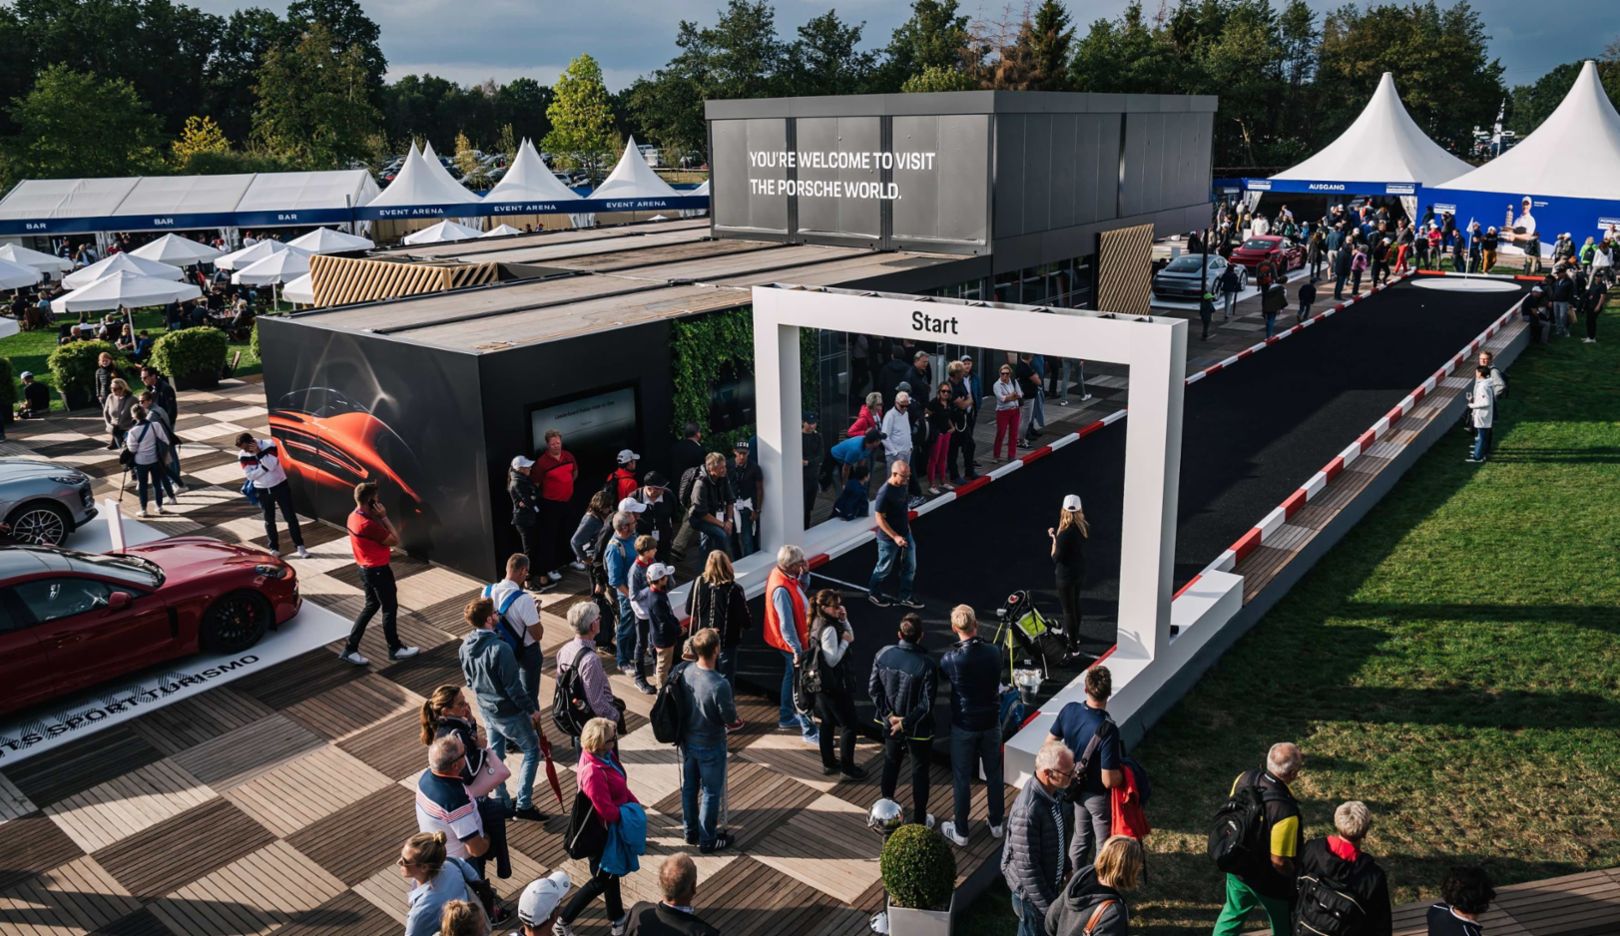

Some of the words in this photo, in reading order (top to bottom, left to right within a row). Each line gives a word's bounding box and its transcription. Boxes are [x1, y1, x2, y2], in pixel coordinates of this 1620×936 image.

[750, 151, 796, 168] YOU'RE
[799, 151, 871, 169] WELCOME
[873, 152, 893, 170] TO
[897, 152, 935, 170] VISIT
[750, 178, 775, 195] THE
[778, 180, 842, 198] PORSCHE
[844, 182, 902, 200] WORLD.
[1308, 183, 1345, 191] AUSGANG
[494, 205, 523, 213] EVENT
[526, 203, 557, 212] ARENA
[606, 201, 634, 209] EVENT
[637, 200, 667, 208] ARENA
[379, 208, 410, 216] EVENT
[412, 206, 444, 215] ARENA
[153, 217, 174, 226] BAR
[277, 213, 298, 221] BAR
[25, 222, 47, 230] BAR
[911, 310, 959, 335] Start
[47, 694, 141, 736] SPORT
[142, 654, 260, 699] TURISMO
